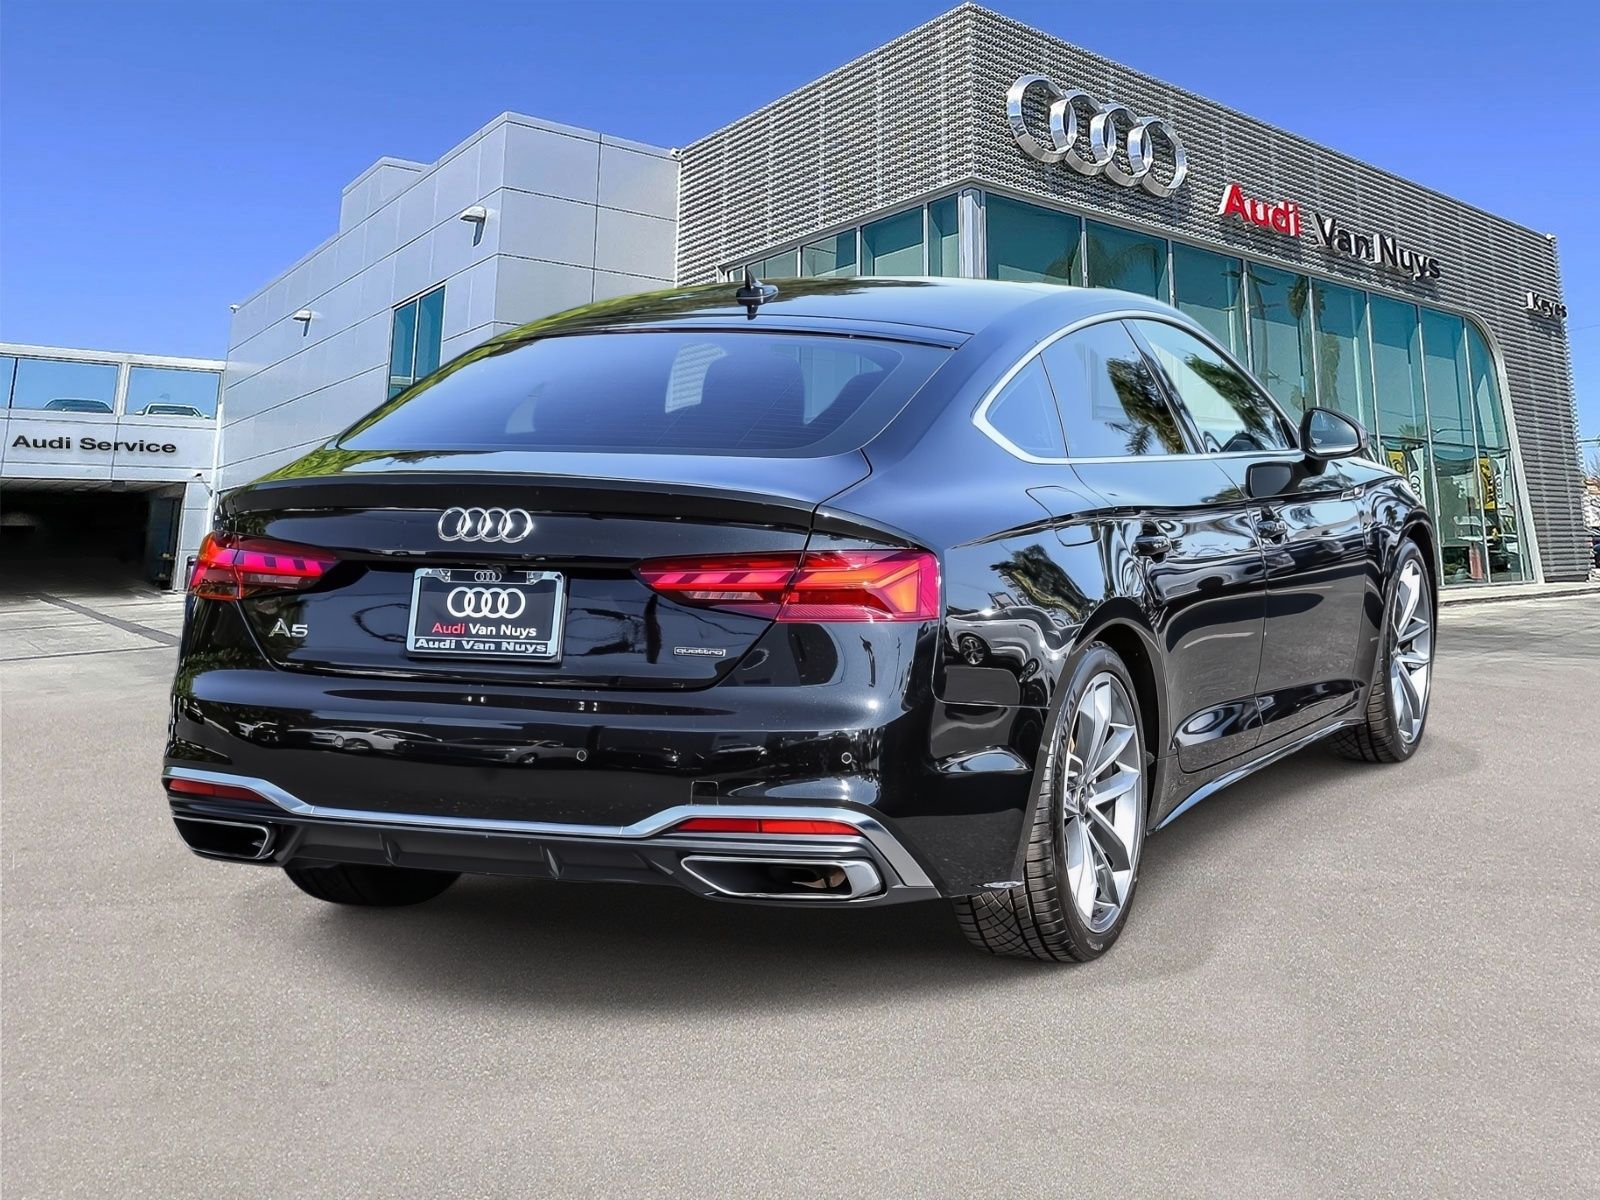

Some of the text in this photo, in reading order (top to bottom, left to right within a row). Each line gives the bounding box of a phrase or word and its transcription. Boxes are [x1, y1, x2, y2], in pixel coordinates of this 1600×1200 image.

[1217, 183, 1441, 281] Audi Van Nuys
[12, 434, 177, 454] Audi Service
[268, 617, 309, 638] A5
[432, 622, 537, 639] Audi Van Nuys
[415, 638, 547, 654] Audi Van Nuys
[675, 647, 724, 656] quattro
